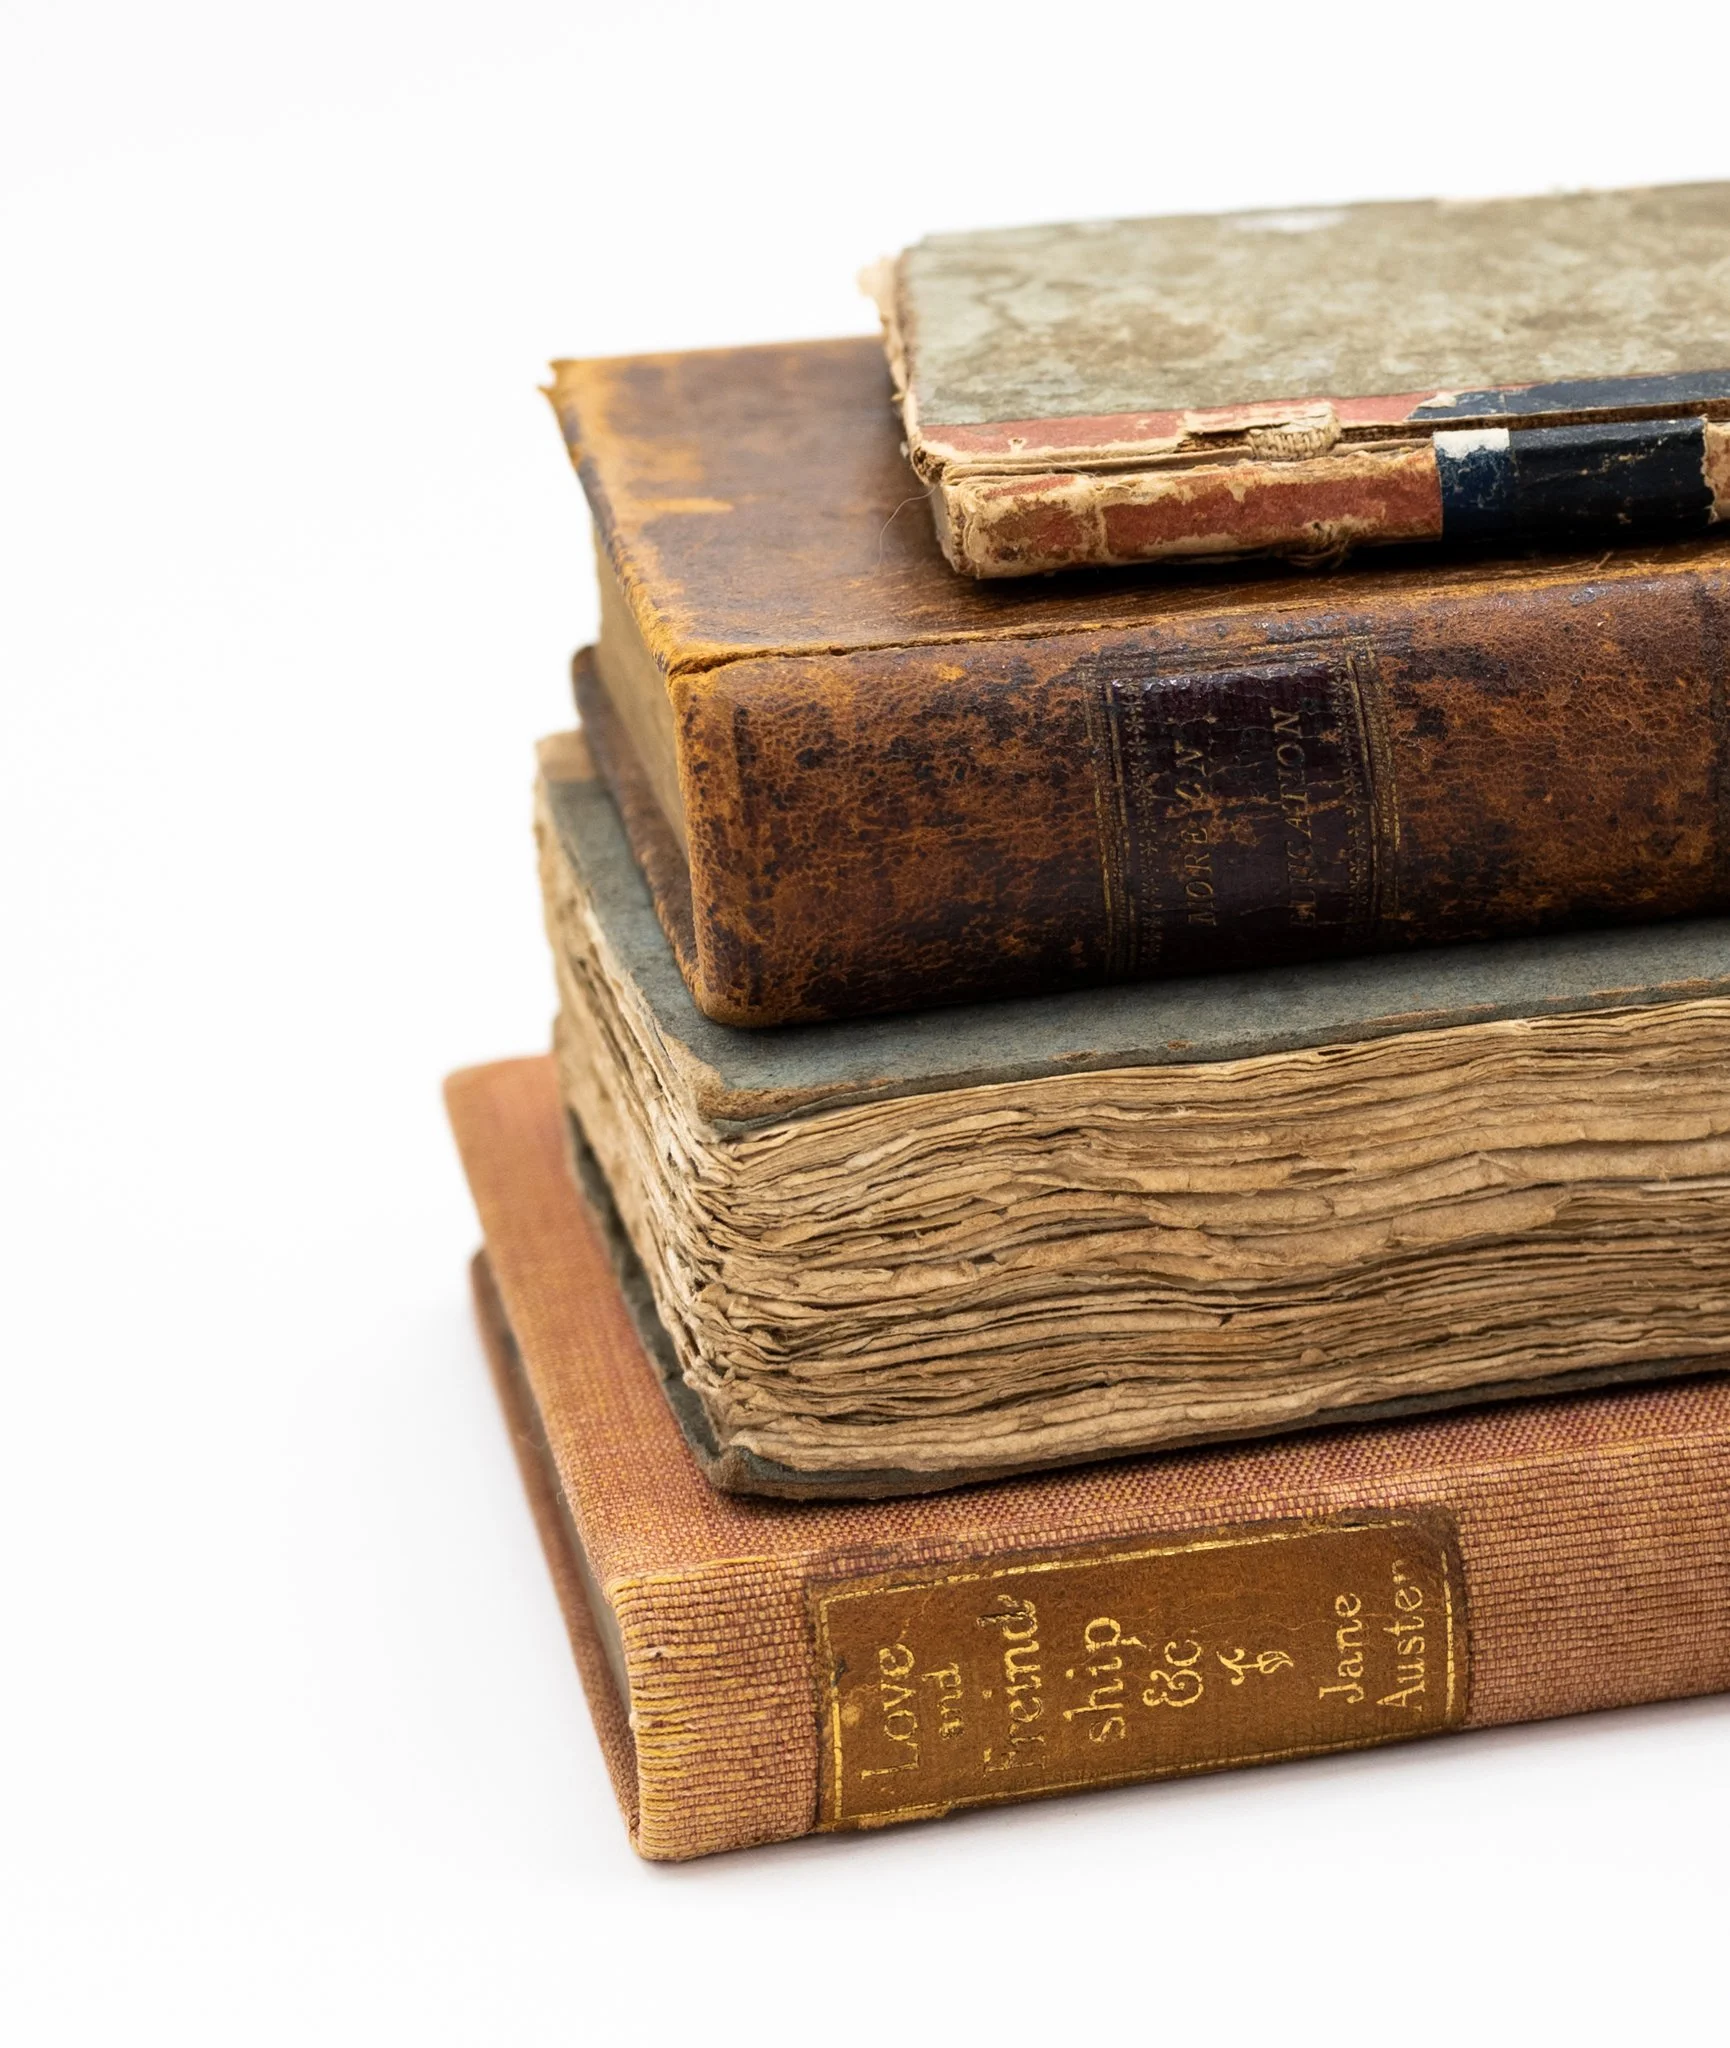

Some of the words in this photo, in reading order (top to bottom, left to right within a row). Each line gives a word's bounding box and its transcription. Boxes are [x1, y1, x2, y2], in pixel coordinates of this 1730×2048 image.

[1179, 816, 1218, 926] MORE
[1063, 1616, 1152, 1743] ship
[1318, 1592, 1366, 1705] Jane
[1376, 1558, 1427, 1713] Austen
[861, 1643, 919, 1780] Love
[921, 1661, 964, 1740] and
